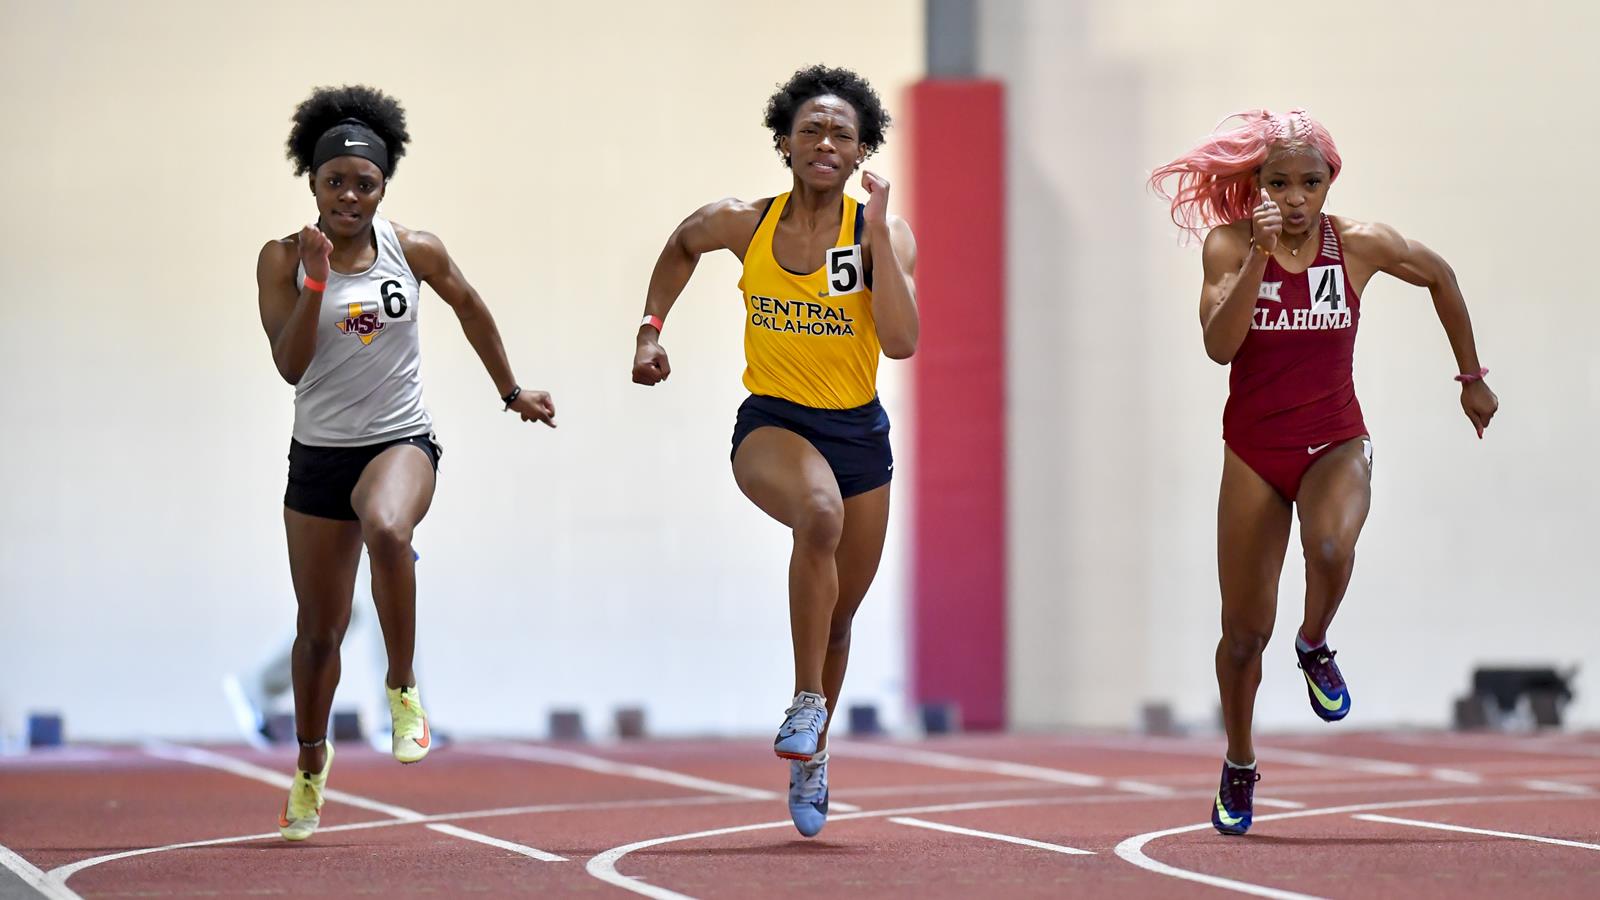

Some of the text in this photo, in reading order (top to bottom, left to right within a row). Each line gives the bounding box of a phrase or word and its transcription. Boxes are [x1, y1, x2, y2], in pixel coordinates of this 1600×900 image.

[831, 249, 858, 292] 5
[380, 280, 408, 319] 6
[1315, 268, 1341, 310] 4
[750, 295, 854, 322] CENTRAL
[751, 312, 855, 337] OKLAHOMA
[1250, 307, 1352, 331] KLAHOMA
